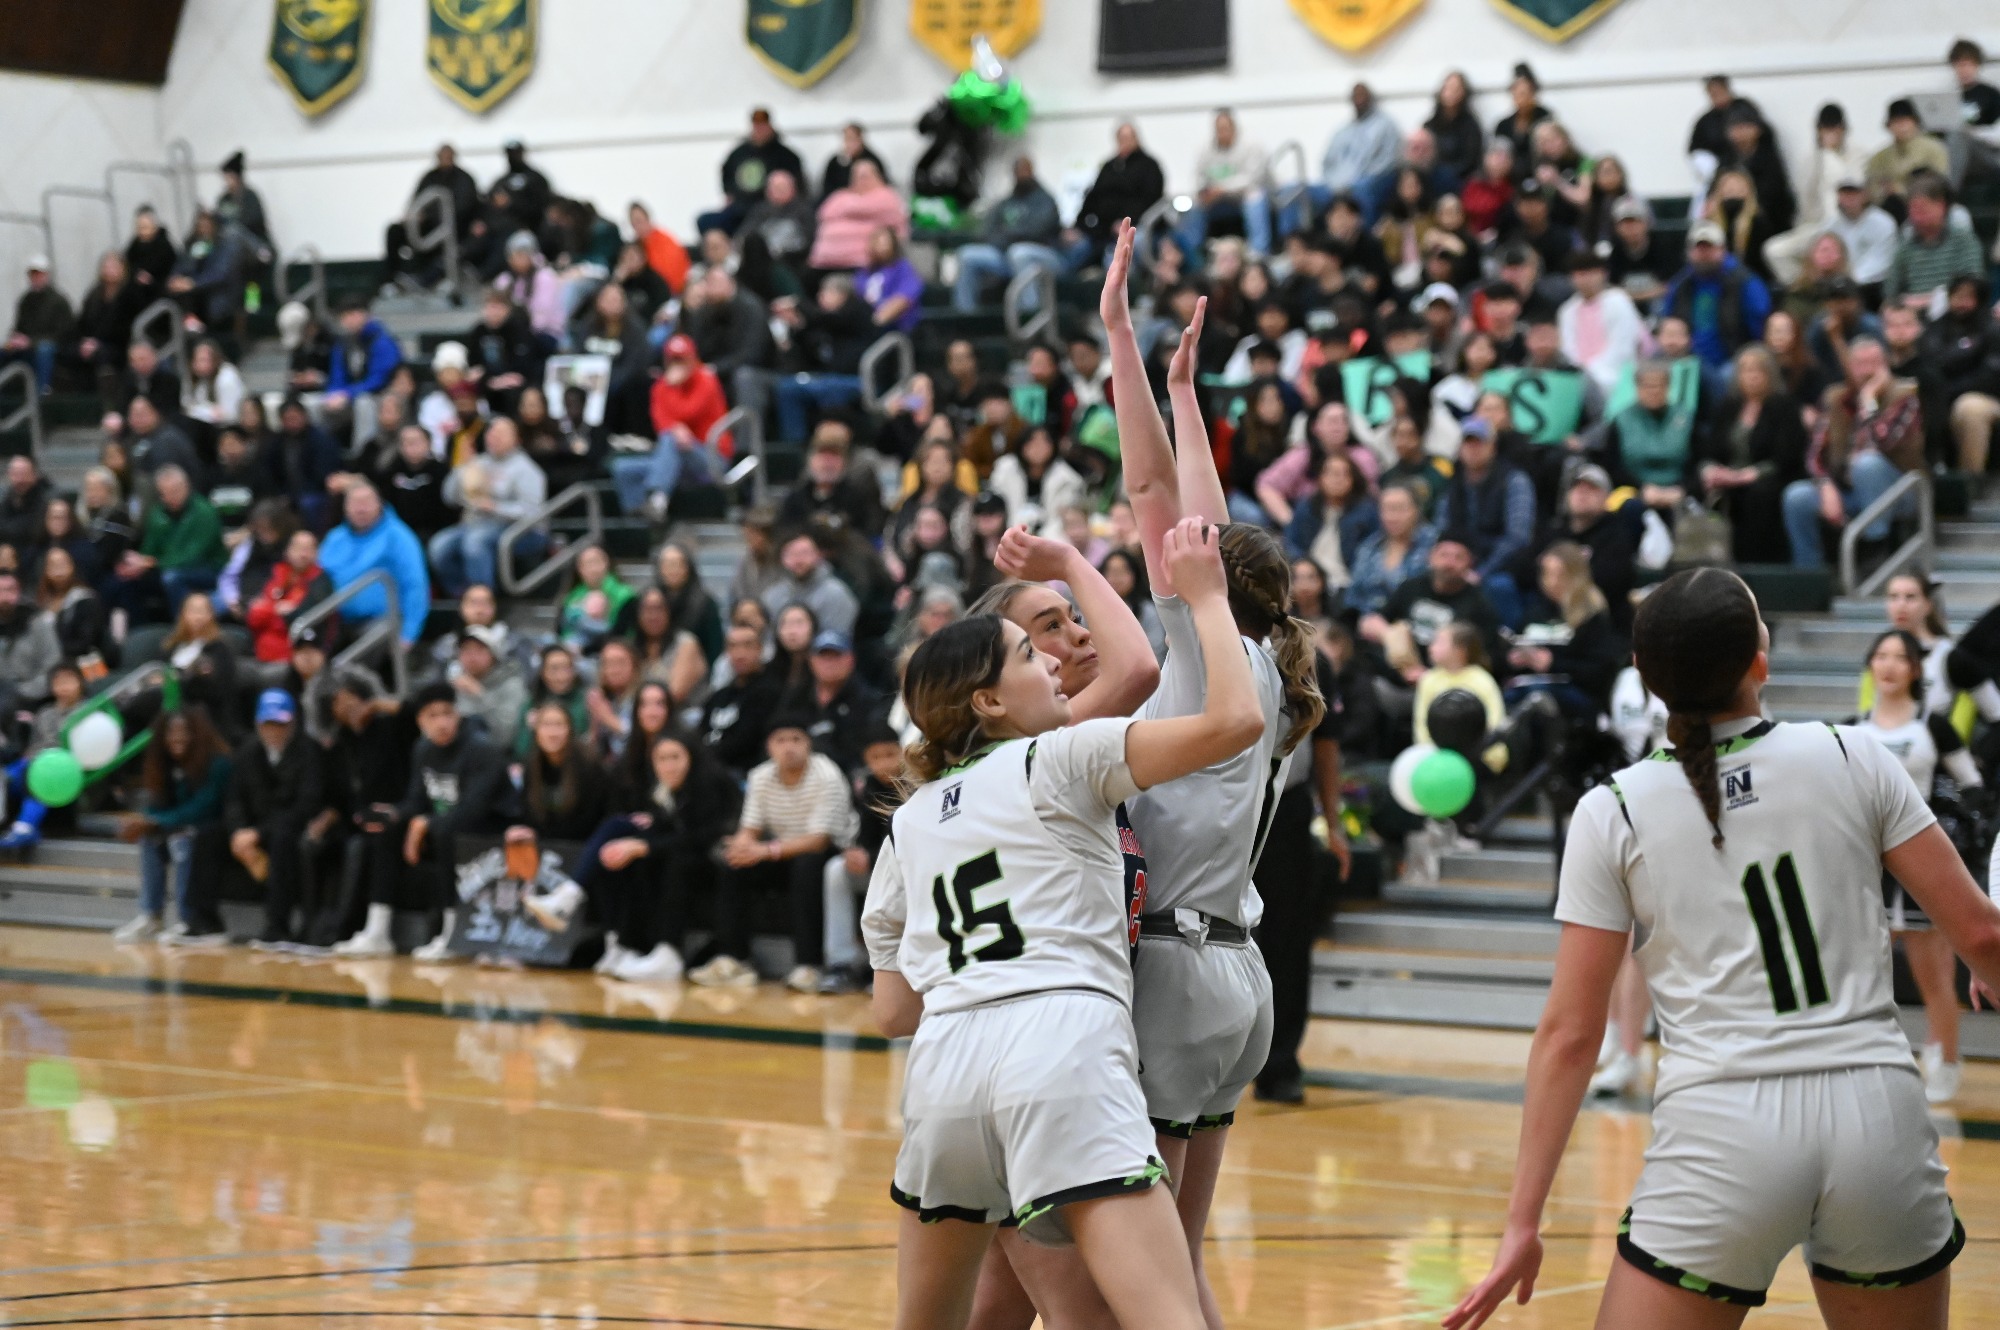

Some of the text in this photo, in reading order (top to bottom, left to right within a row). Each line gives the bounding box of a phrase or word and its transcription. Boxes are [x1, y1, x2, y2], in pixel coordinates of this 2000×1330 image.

[1510, 376, 1546, 435] S
[932, 847, 1026, 975] 15
[1740, 850, 1831, 1016] 11
